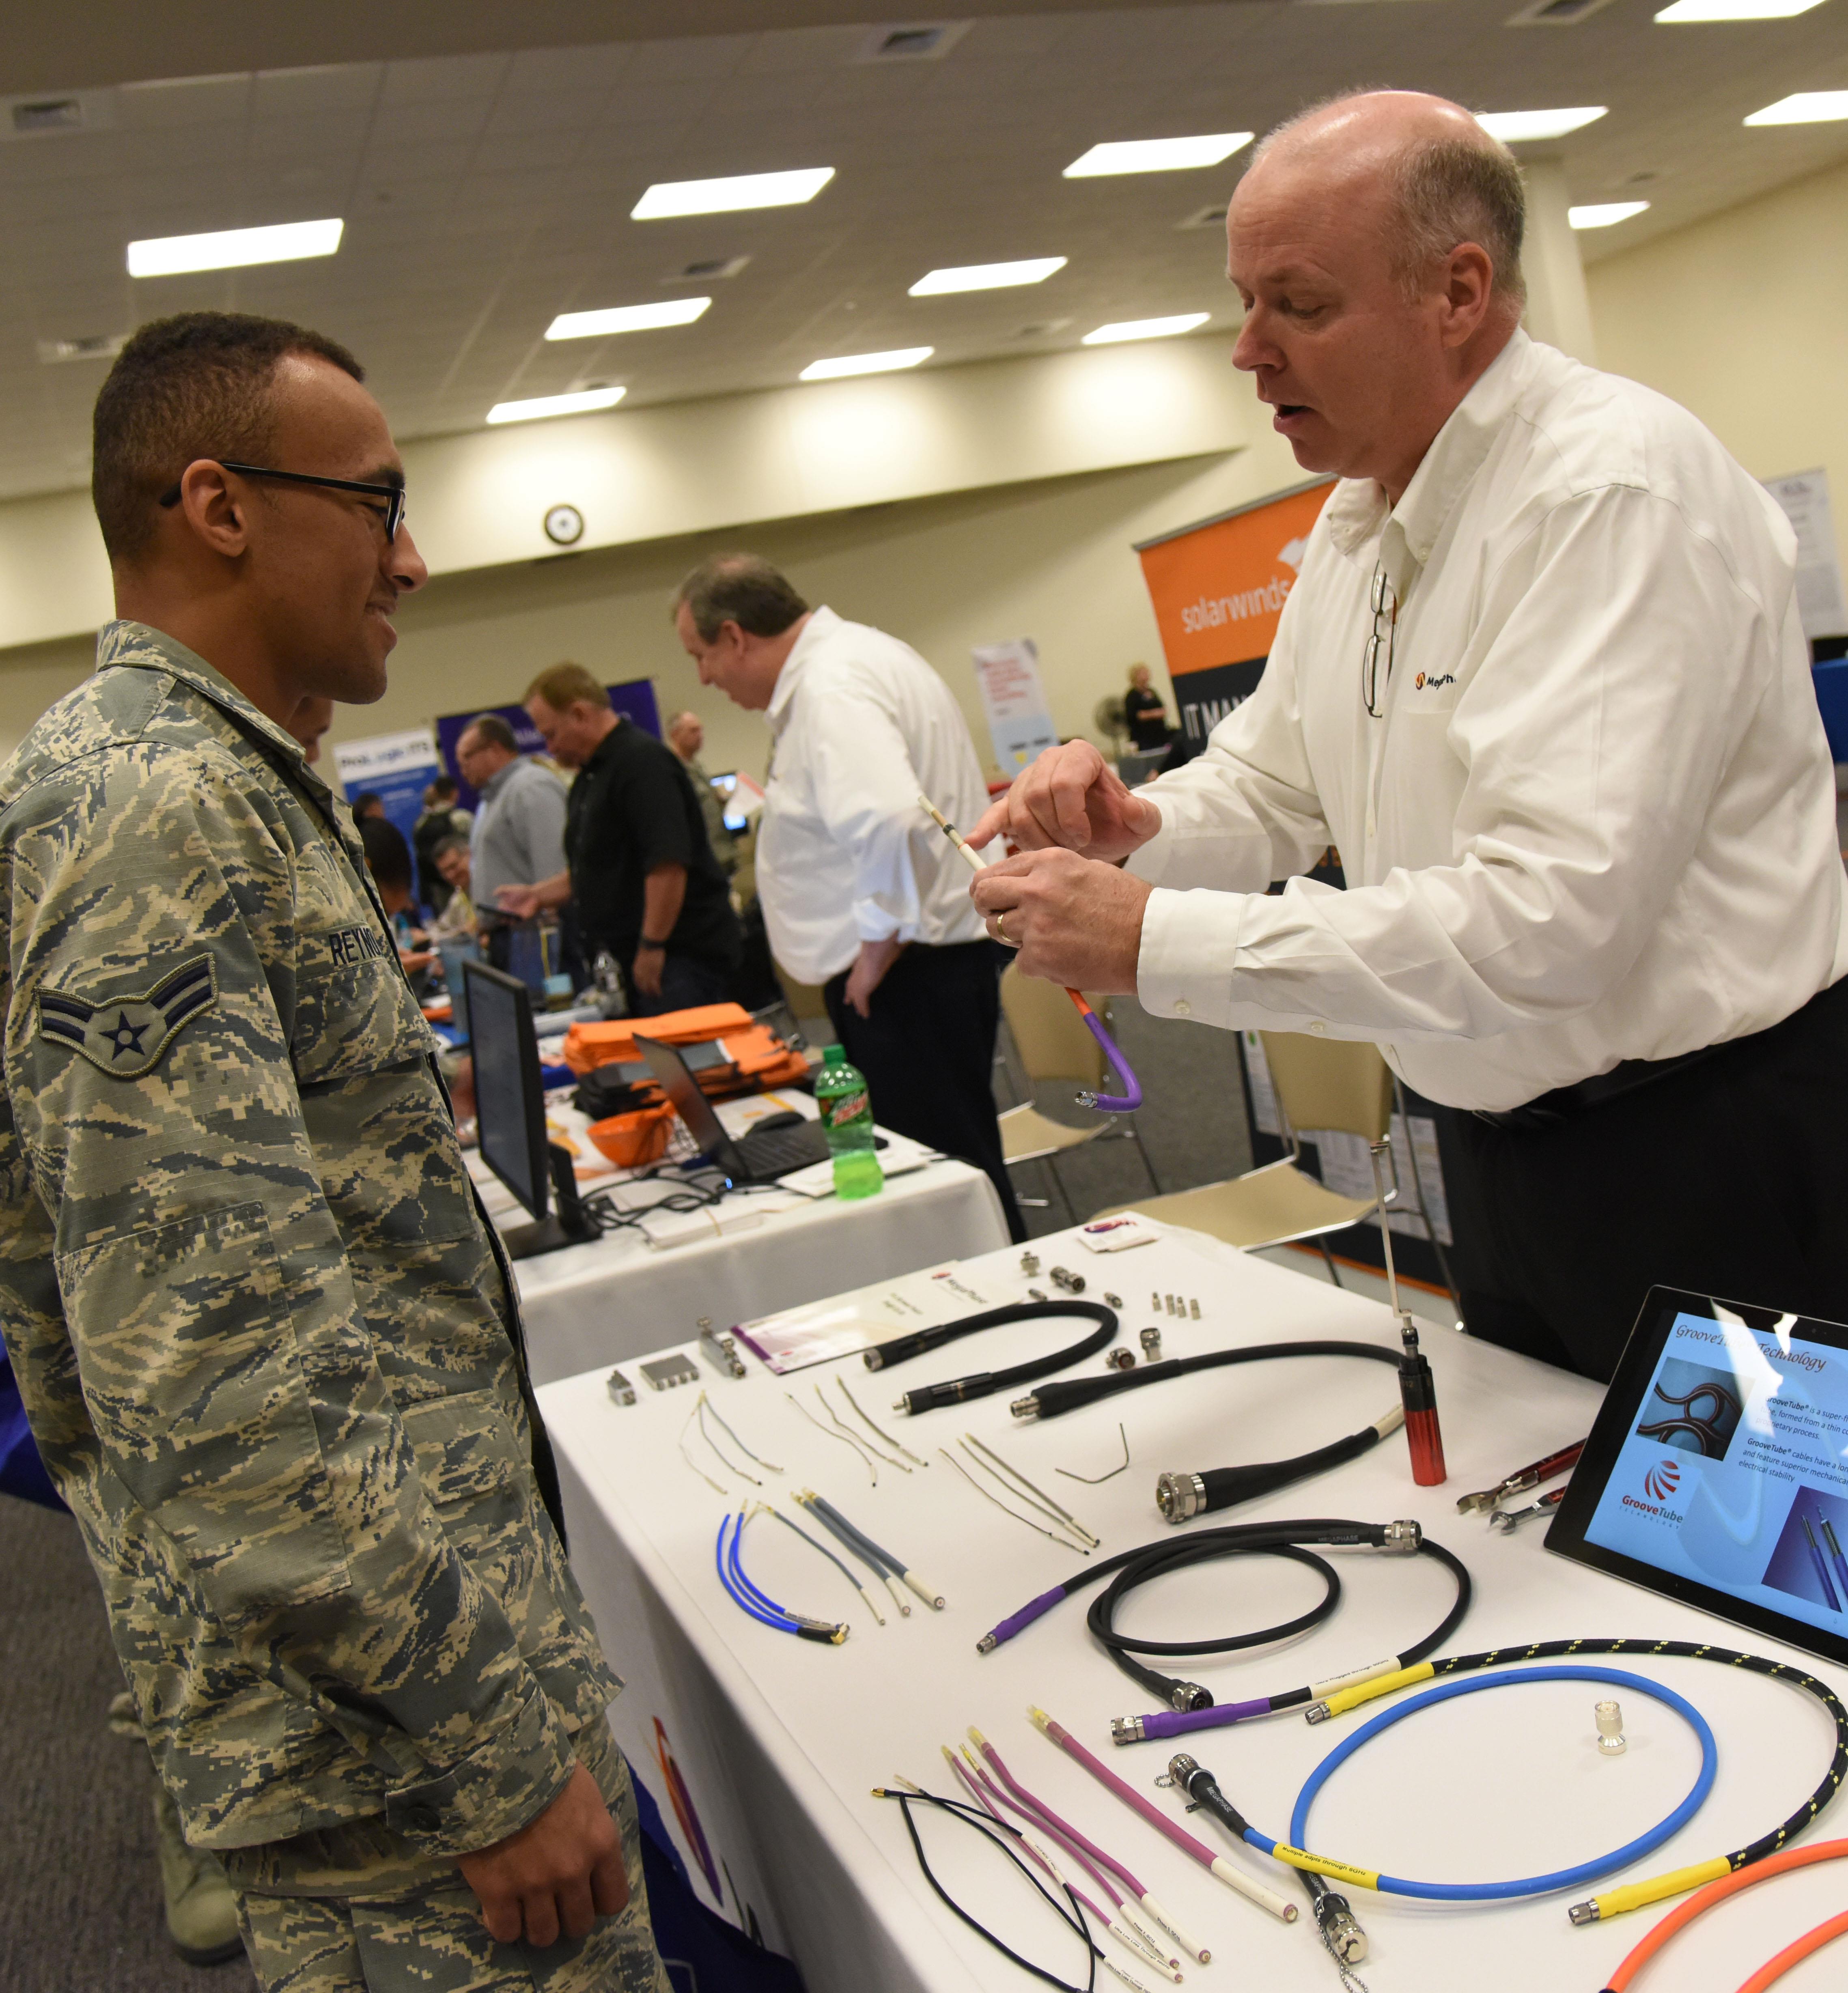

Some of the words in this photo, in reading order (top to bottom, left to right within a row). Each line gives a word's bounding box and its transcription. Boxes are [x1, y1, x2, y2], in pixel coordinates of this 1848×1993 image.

[1182, 575, 1290, 634] solarwinds
[1182, 702, 1200, 740] IT
[1756, 1343, 1826, 1373] Technology
[1779, 1410, 1803, 1423] formed
[1804, 1417, 1820, 1427] from
[1827, 1423, 1841, 1433] thin
[1793, 1428, 1820, 1440] process.
[1742, 1449, 1755, 1458] and
[1756, 1452, 1780, 1465] feature
[1781, 1461, 1809, 1473] superior
[1810, 1469, 1848, 1485] mechanical
[1747, 1438, 1792, 1455] GrooveTube®
[1792, 1451, 1813, 1462] cables
[1814, 1457, 1831, 1467] have
[1838, 1463, 1848, 1473] lon
[1738, 1460, 1768, 1474] electrical
[1768, 1469, 1795, 1483] stability
[1619, 1506, 1679, 1530] TECHNOLOGY
[1622, 1495, 1683, 1523] GrooveTube
[1206, 1786, 1233, 1813] MEGAPHASE
[1282, 1846, 1303, 1857] Multiple
[1322, 1860, 1347, 1870] through
[1349, 1867, 1366, 1876] 6GHz
[1114, 1926, 1122, 1934] Ultra
[1131, 1939, 1139, 1948] Loss
[1140, 1947, 1157, 1961] Through
[1130, 1979, 1142, 1990] Through
